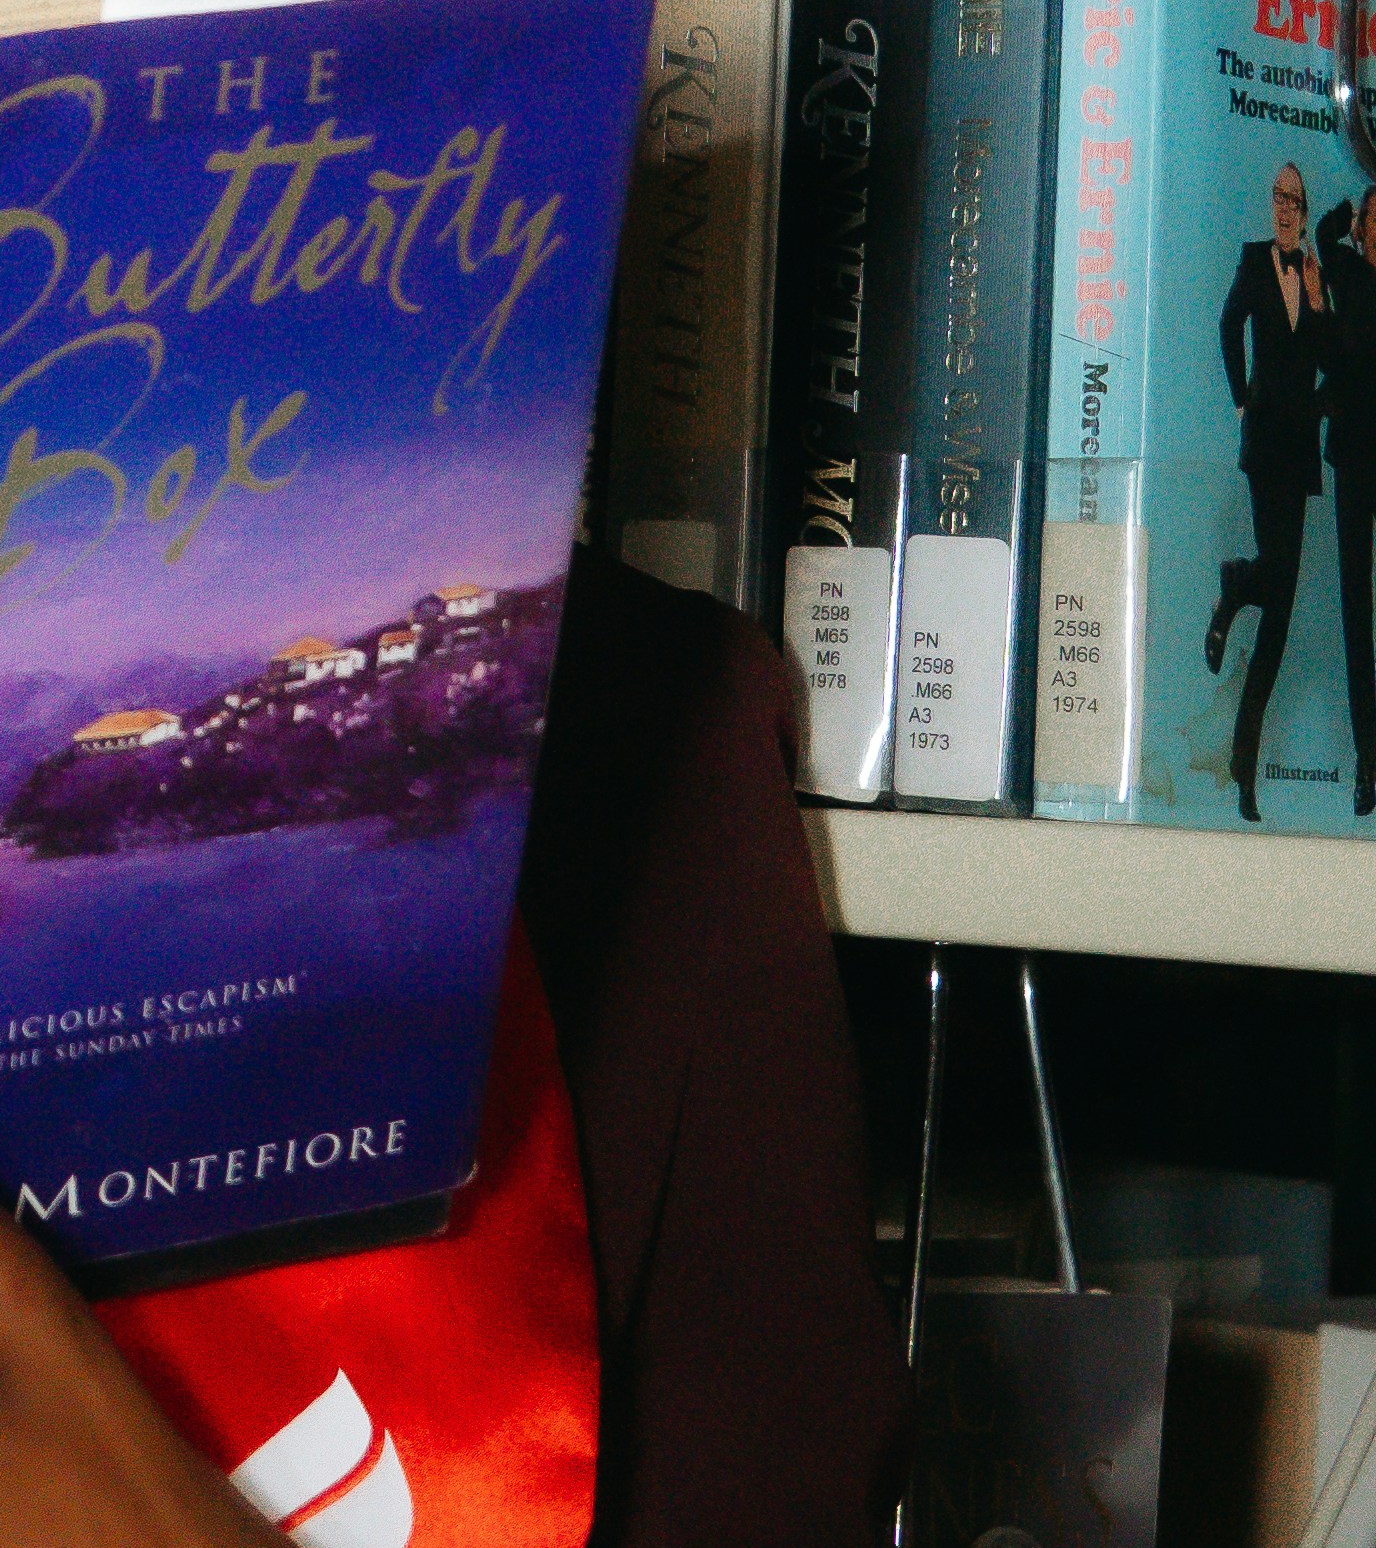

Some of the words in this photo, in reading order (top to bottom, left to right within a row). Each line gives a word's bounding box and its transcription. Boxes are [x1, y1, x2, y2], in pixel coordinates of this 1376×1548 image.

[1216, 48, 1254, 80] The
[141, 49, 345, 122] THE
[1081, 84, 1117, 128] &
[650, 24, 720, 405] KENNETH
[801, 18, 880, 413] KENNETH
[945, 117, 991, 375] Morecambe
[1075, 136, 1133, 343] Ernie
[939, 426, 982, 536] Wise
[820, 582, 843, 598] PN
[1054, 594, 1083, 611] PN
[811, 605, 850, 621] 2598
[1053, 620, 1101, 638] 2598
[913, 631, 939, 648] PN
[816, 651, 840, 666] M6
[911, 657, 954, 674] 2598
[810, 673, 847, 689] 1978
[1051, 670, 1078, 688] A3
[1052, 696, 1098, 714] 1974
[908, 707, 932, 724] A3
[909, 732, 950, 750] 1973
[1266, 762, 1340, 784] Illustrated
[56, 1030, 155, 1060] SUNDAY
[169, 1015, 245, 1043] TIMES
[14, 1118, 409, 1224] MONTEFIORE
